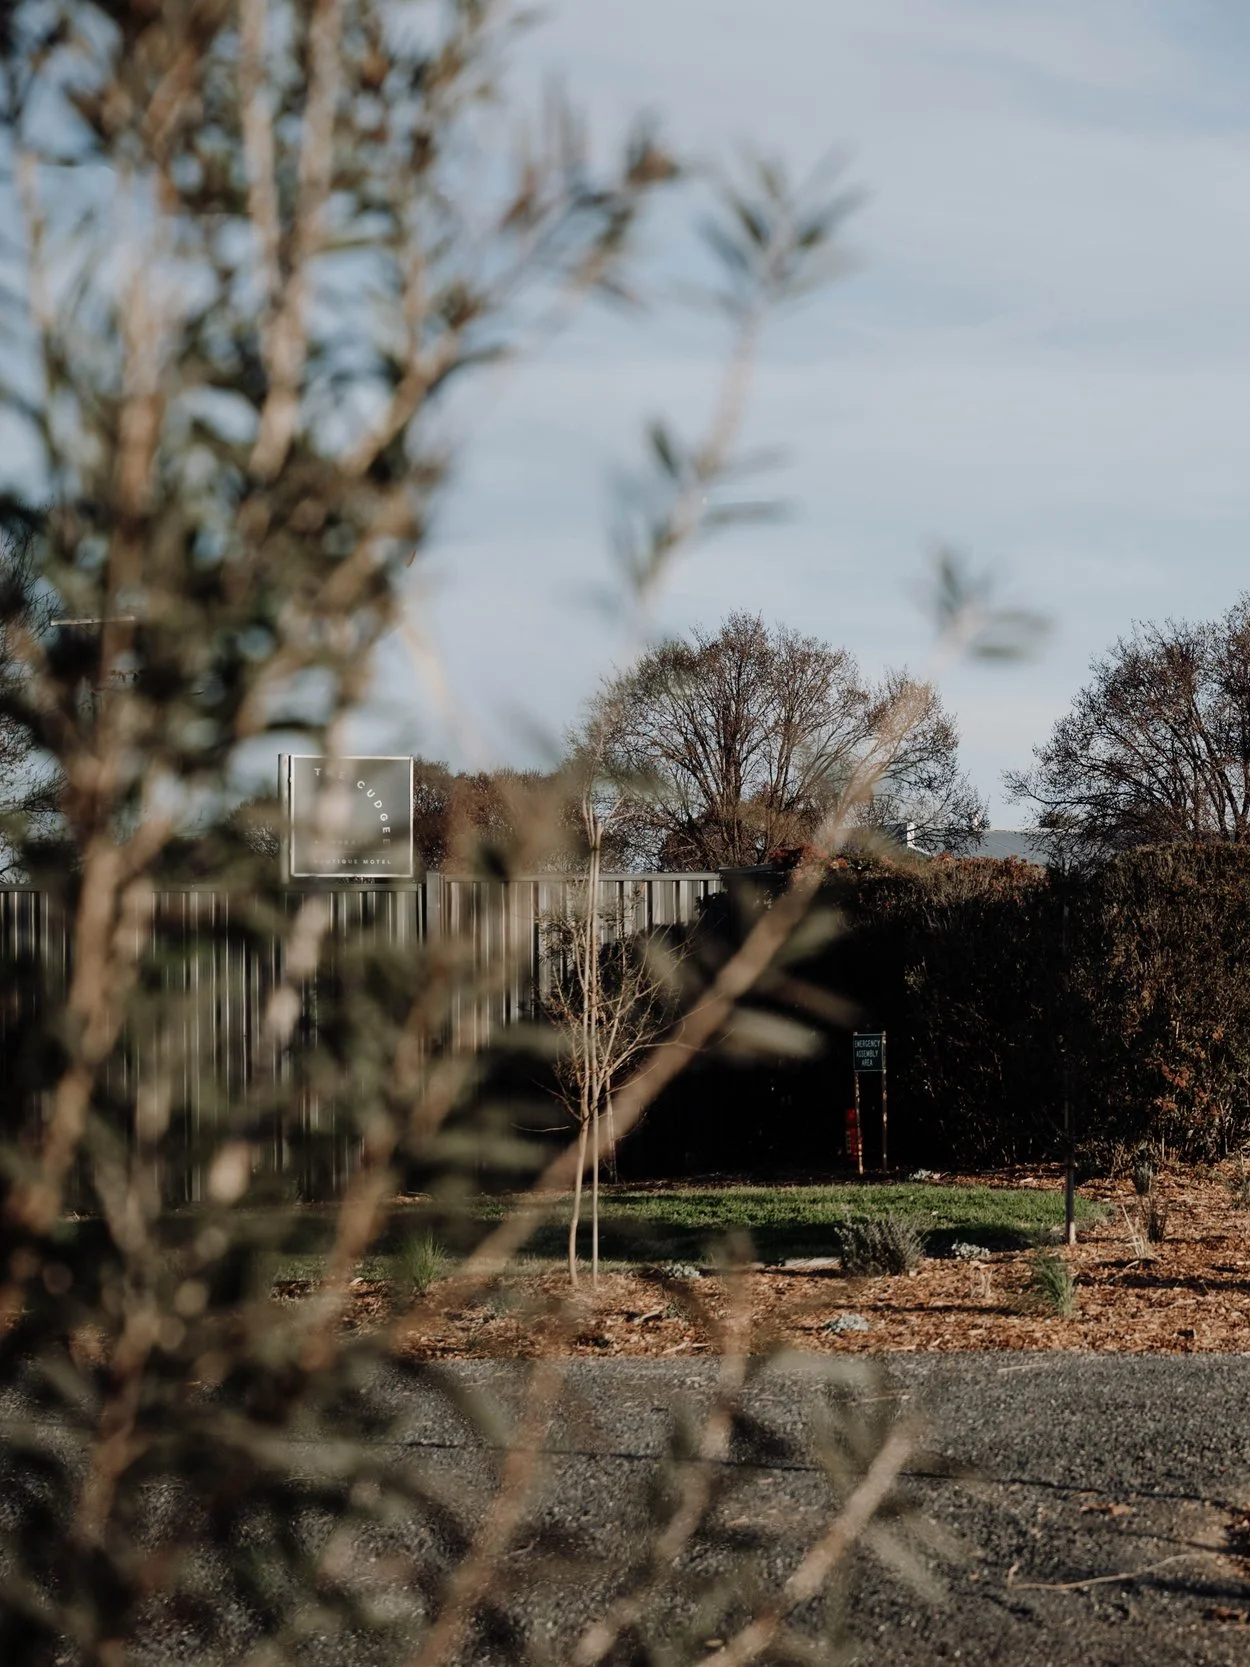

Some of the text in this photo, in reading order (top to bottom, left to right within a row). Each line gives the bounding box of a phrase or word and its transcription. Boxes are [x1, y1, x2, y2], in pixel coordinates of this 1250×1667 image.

[357, 781, 391, 845] CUDGEE
[854, 1040, 881, 1048] EMERGENCY
[856, 1050, 878, 1058] ASSEMBLY
[861, 1058, 873, 1067] AREA
